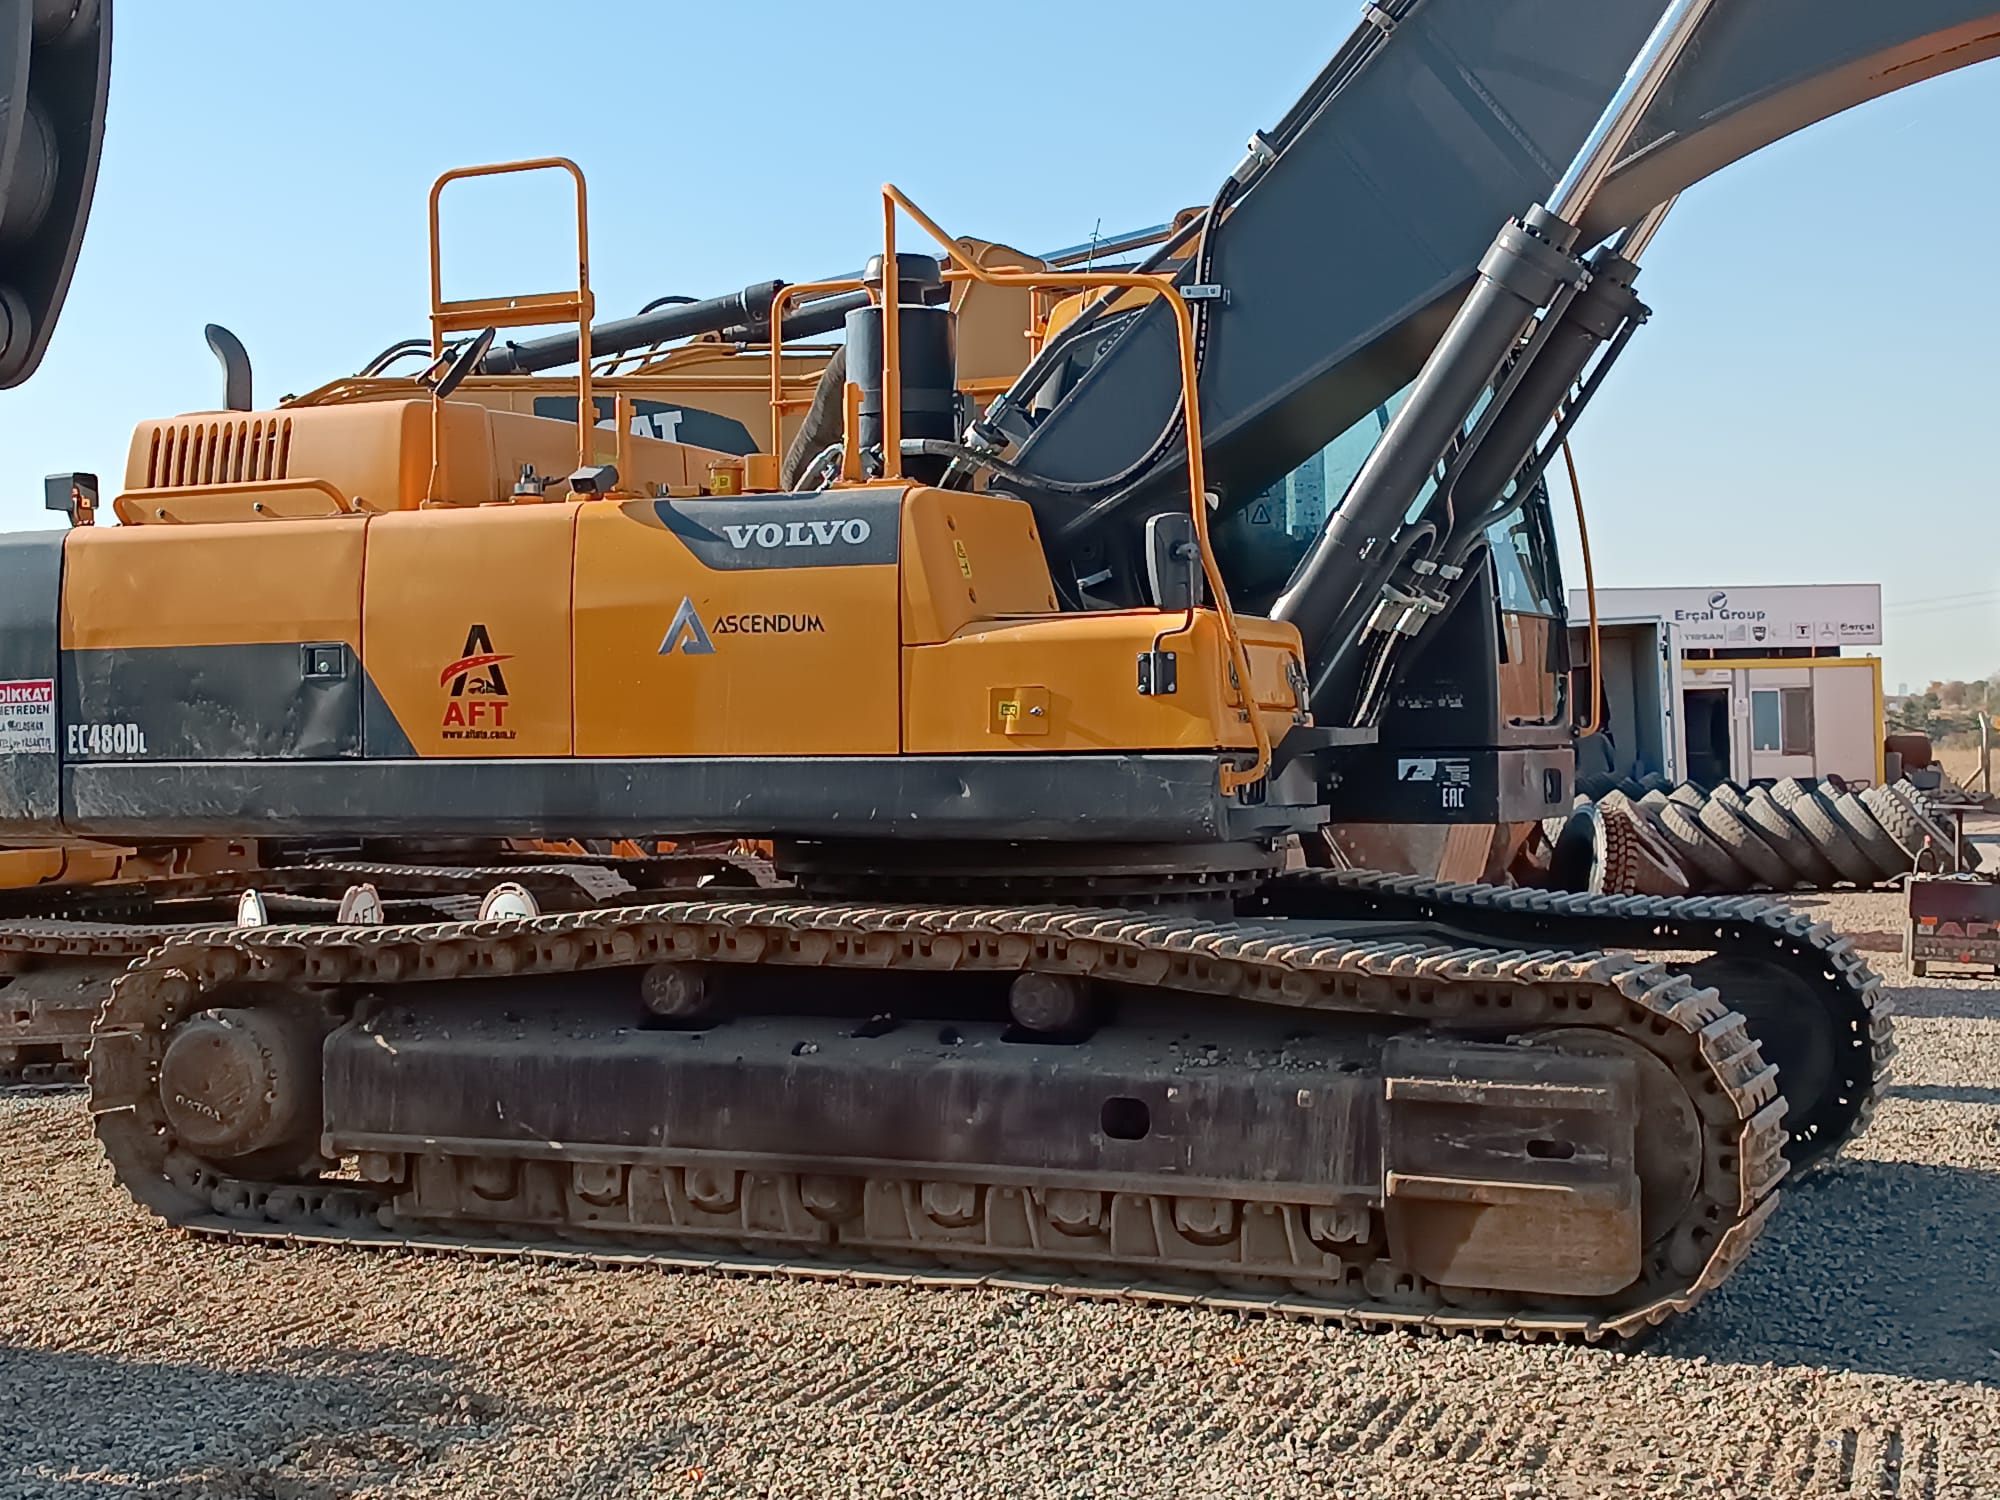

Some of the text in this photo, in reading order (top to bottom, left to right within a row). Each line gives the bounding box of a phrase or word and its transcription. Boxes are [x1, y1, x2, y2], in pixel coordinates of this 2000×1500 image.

[722, 518, 871, 549] VOLVO
[712, 614, 825, 634] ASCENDUM
[1719, 609, 1766, 622] Group
[443, 701, 509, 727] AFT
[1442, 787, 1465, 808] EAC
